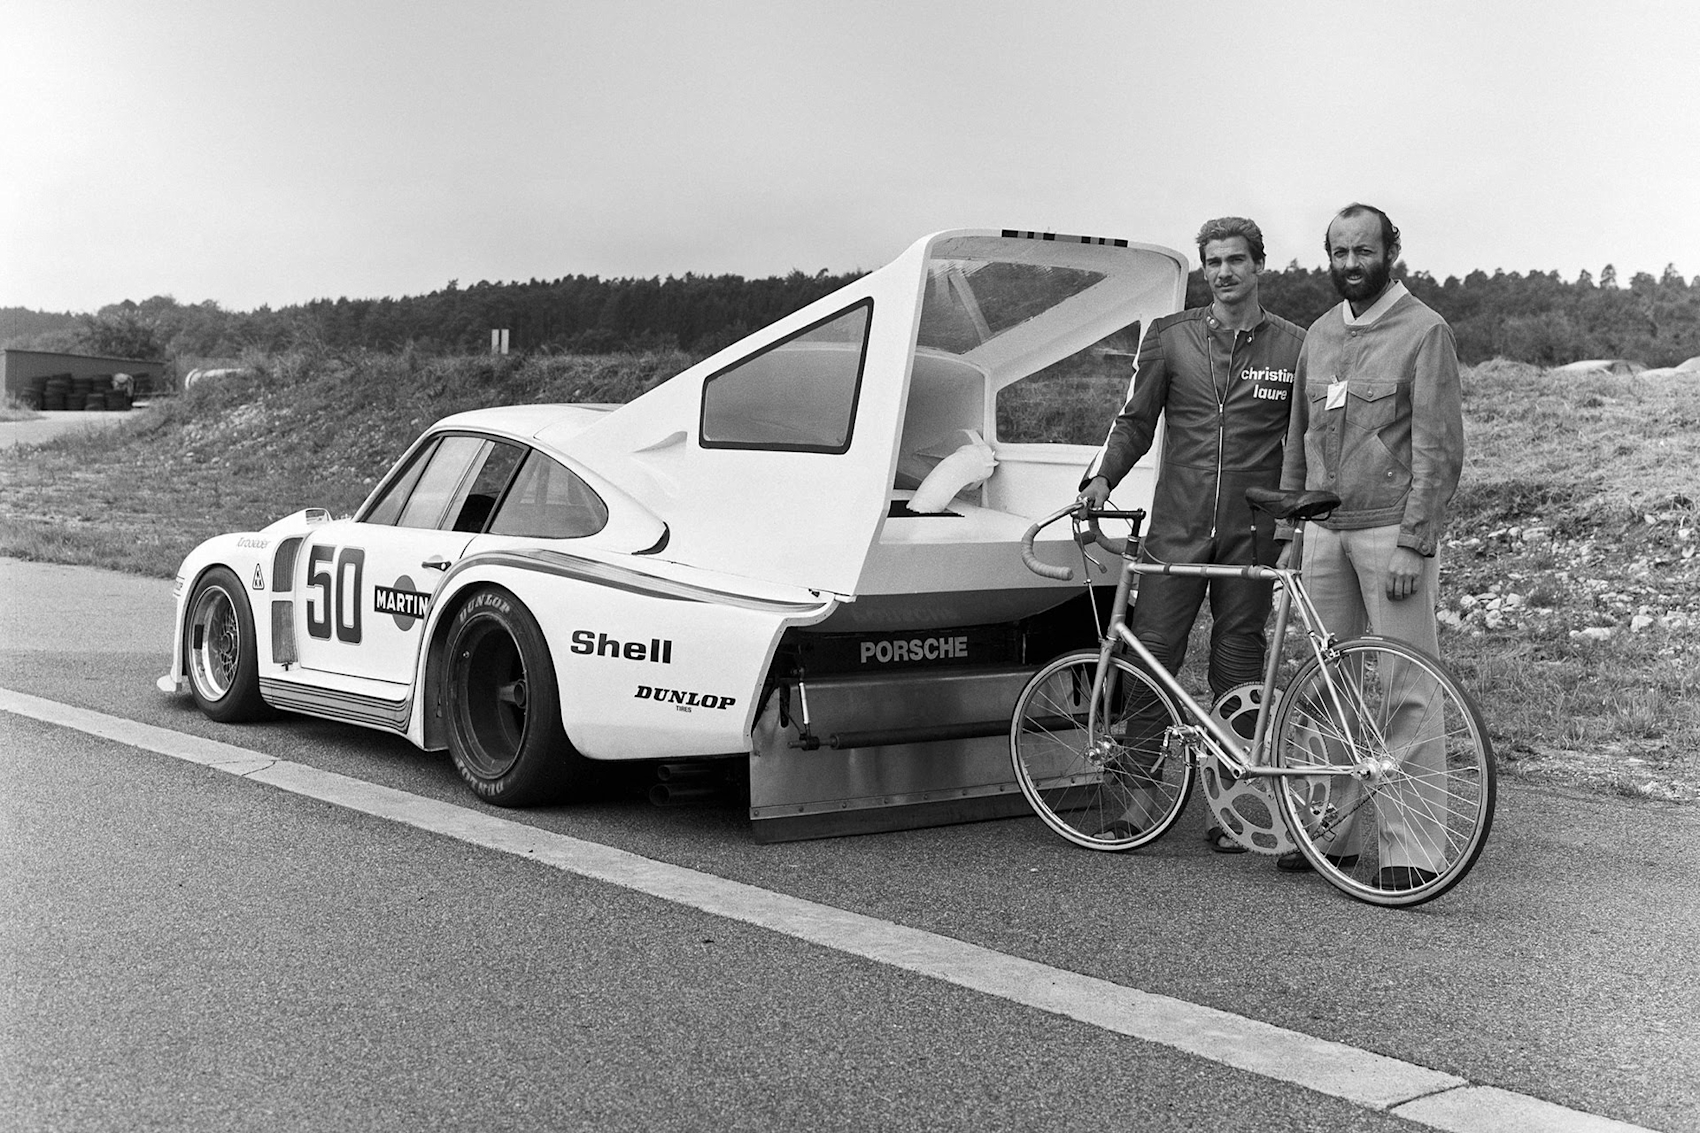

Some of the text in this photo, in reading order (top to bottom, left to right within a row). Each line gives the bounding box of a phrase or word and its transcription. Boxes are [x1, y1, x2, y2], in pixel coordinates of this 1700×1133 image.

[1241, 366, 1296, 383] christin
[1253, 384, 1287, 400] laure
[307, 544, 365, 645] 50
[376, 589, 429, 616] MARTIN
[460, 593, 510, 622] DUNLOP
[570, 630, 672, 664] Shell
[860, 636, 968, 663] PORSCHE
[634, 685, 736, 710] DUNLOP
